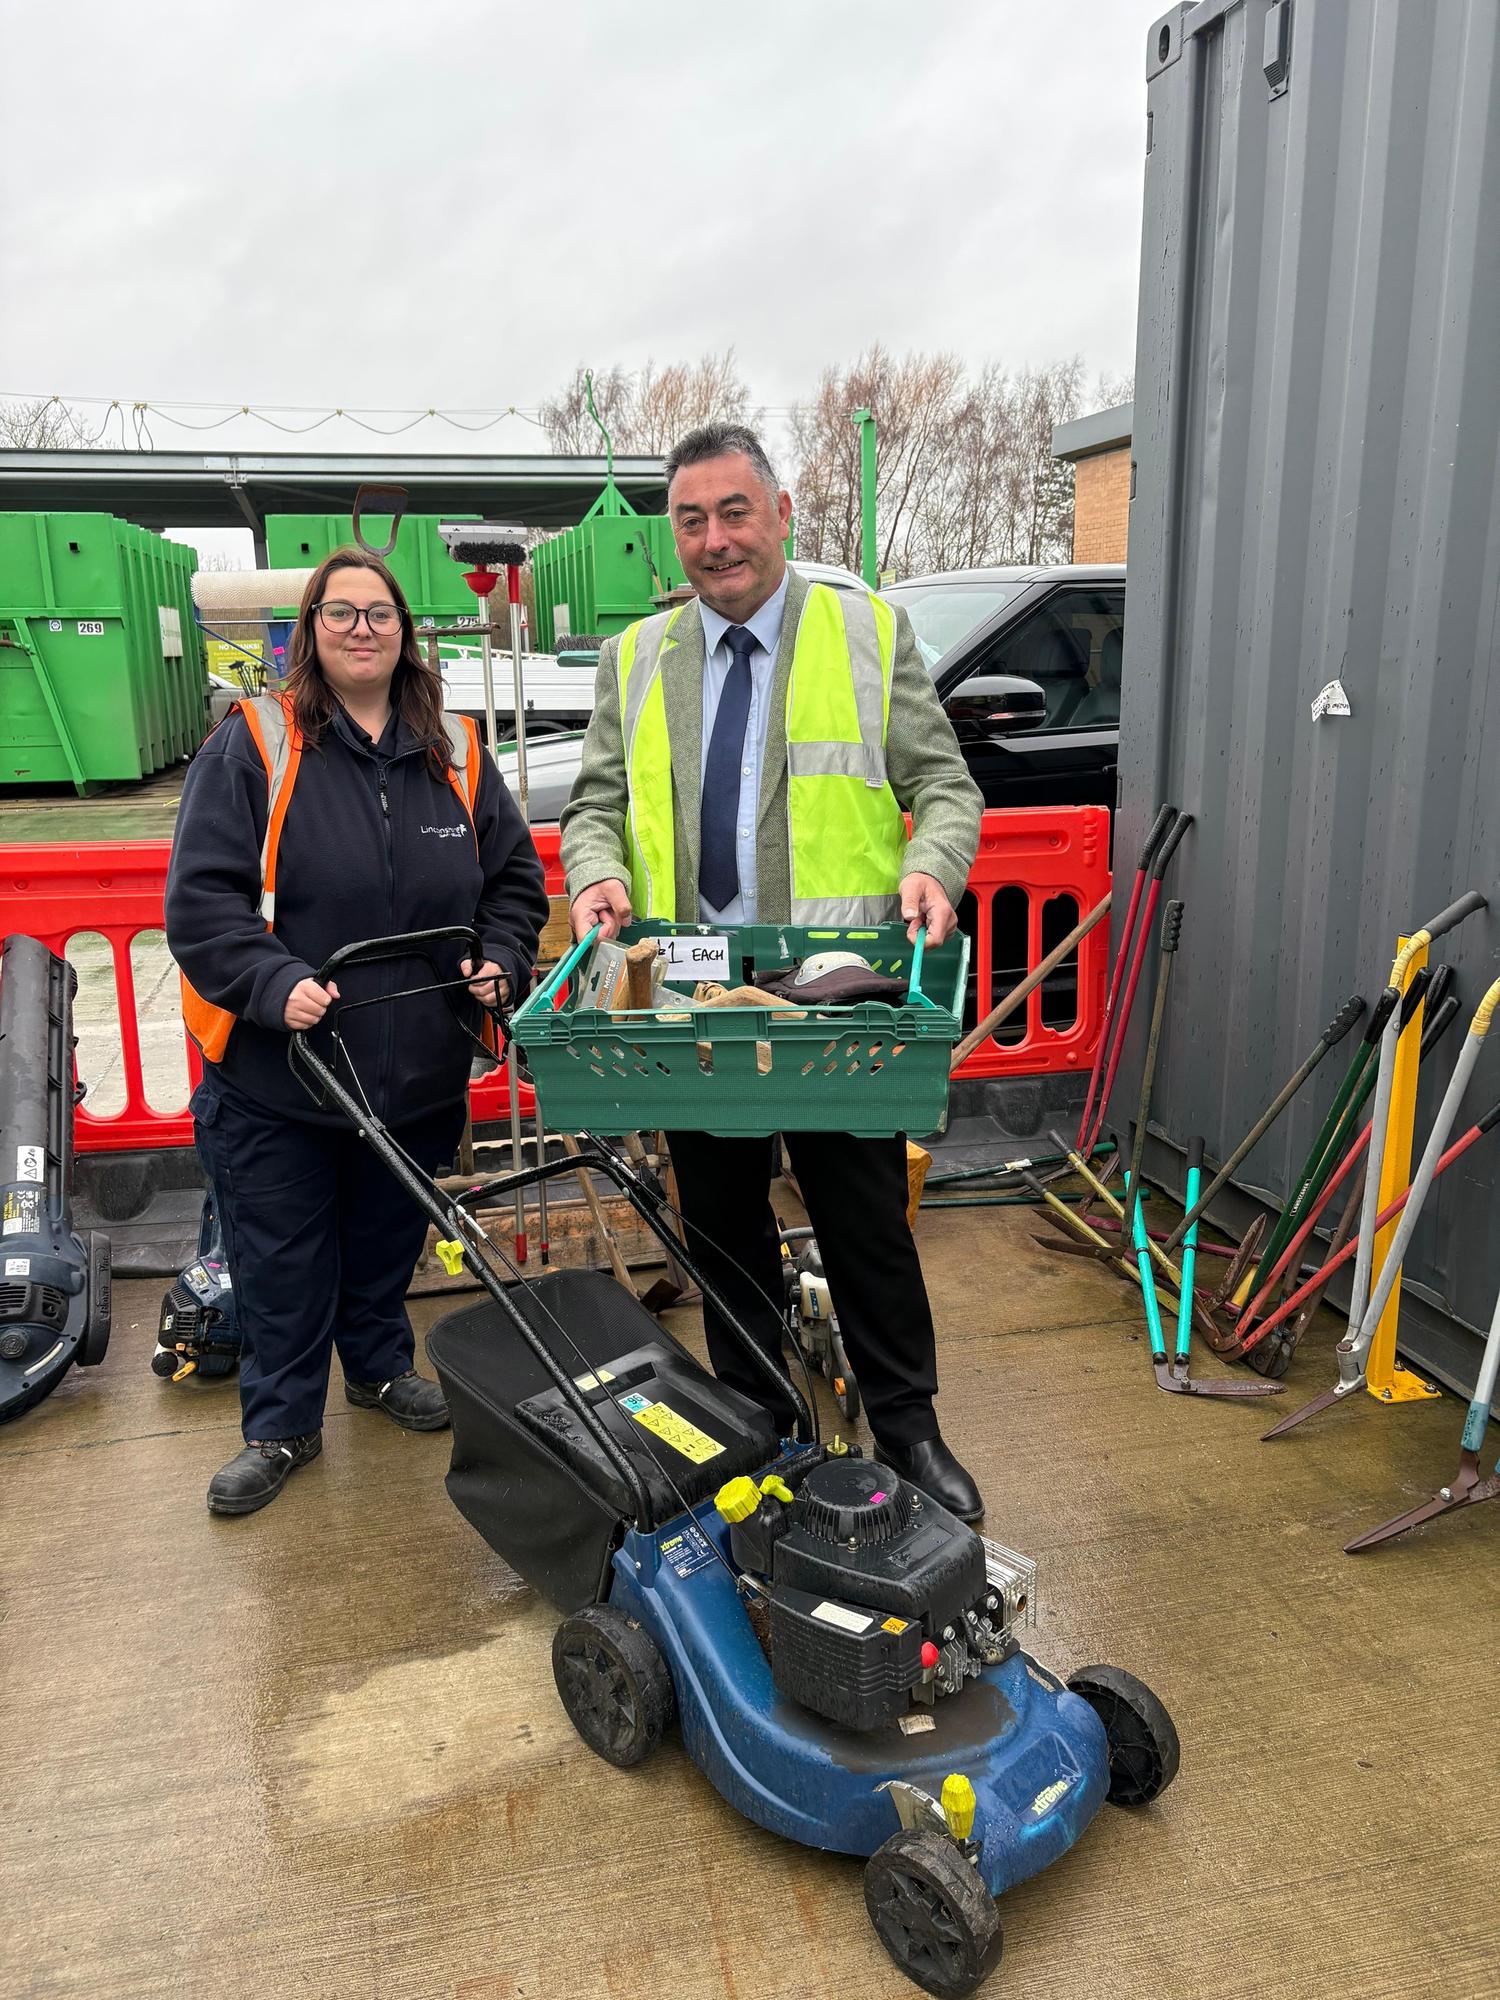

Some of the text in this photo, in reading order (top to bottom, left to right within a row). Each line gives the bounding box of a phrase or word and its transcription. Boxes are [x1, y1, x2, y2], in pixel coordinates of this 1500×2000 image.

[79, 623, 102, 633] 269
[691, 947, 724, 962] EACH
[603, 959, 617, 989] MATE
[660, 1535, 683, 1552] xtreme
[1031, 1780, 1068, 1816] xtreme
